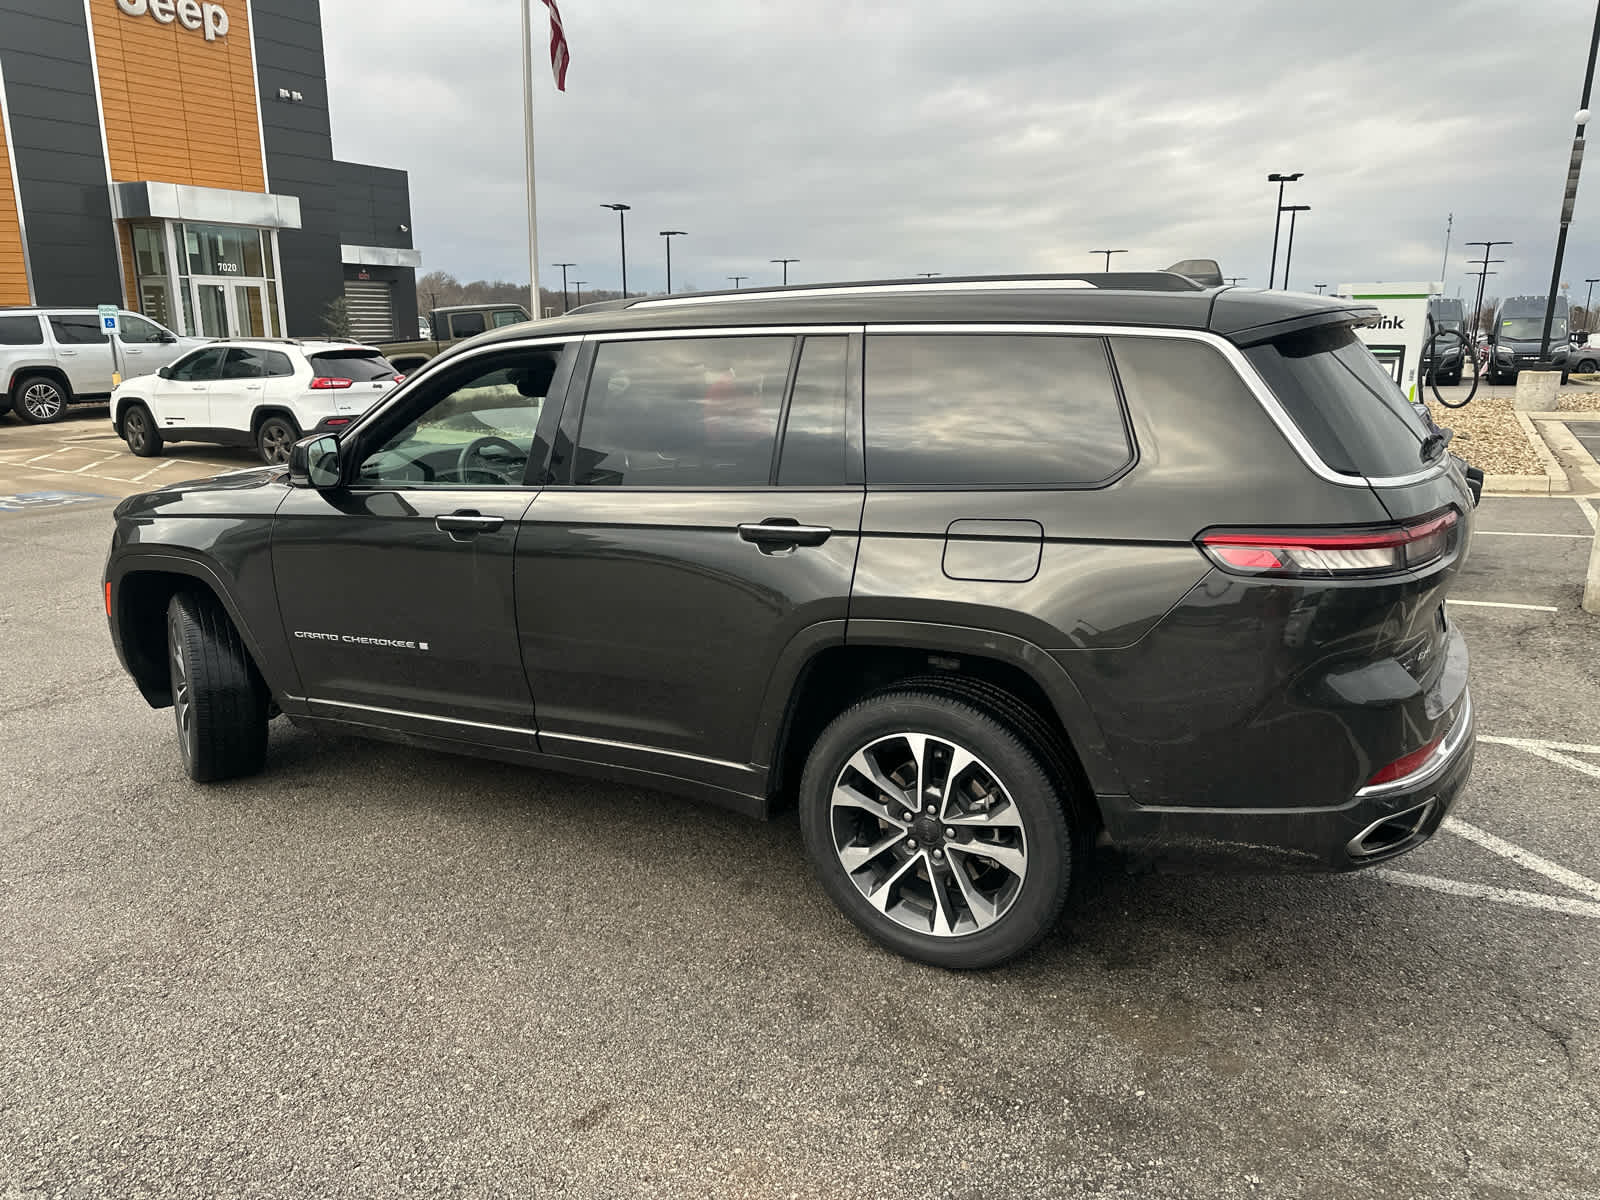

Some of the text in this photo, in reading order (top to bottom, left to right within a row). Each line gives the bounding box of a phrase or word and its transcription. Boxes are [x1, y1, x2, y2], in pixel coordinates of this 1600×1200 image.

[217, 262, 237, 272] 7020
[1366, 315, 1405, 329] ink
[294, 631, 339, 641] GRAND
[341, 635, 416, 649] CHEROKEE
